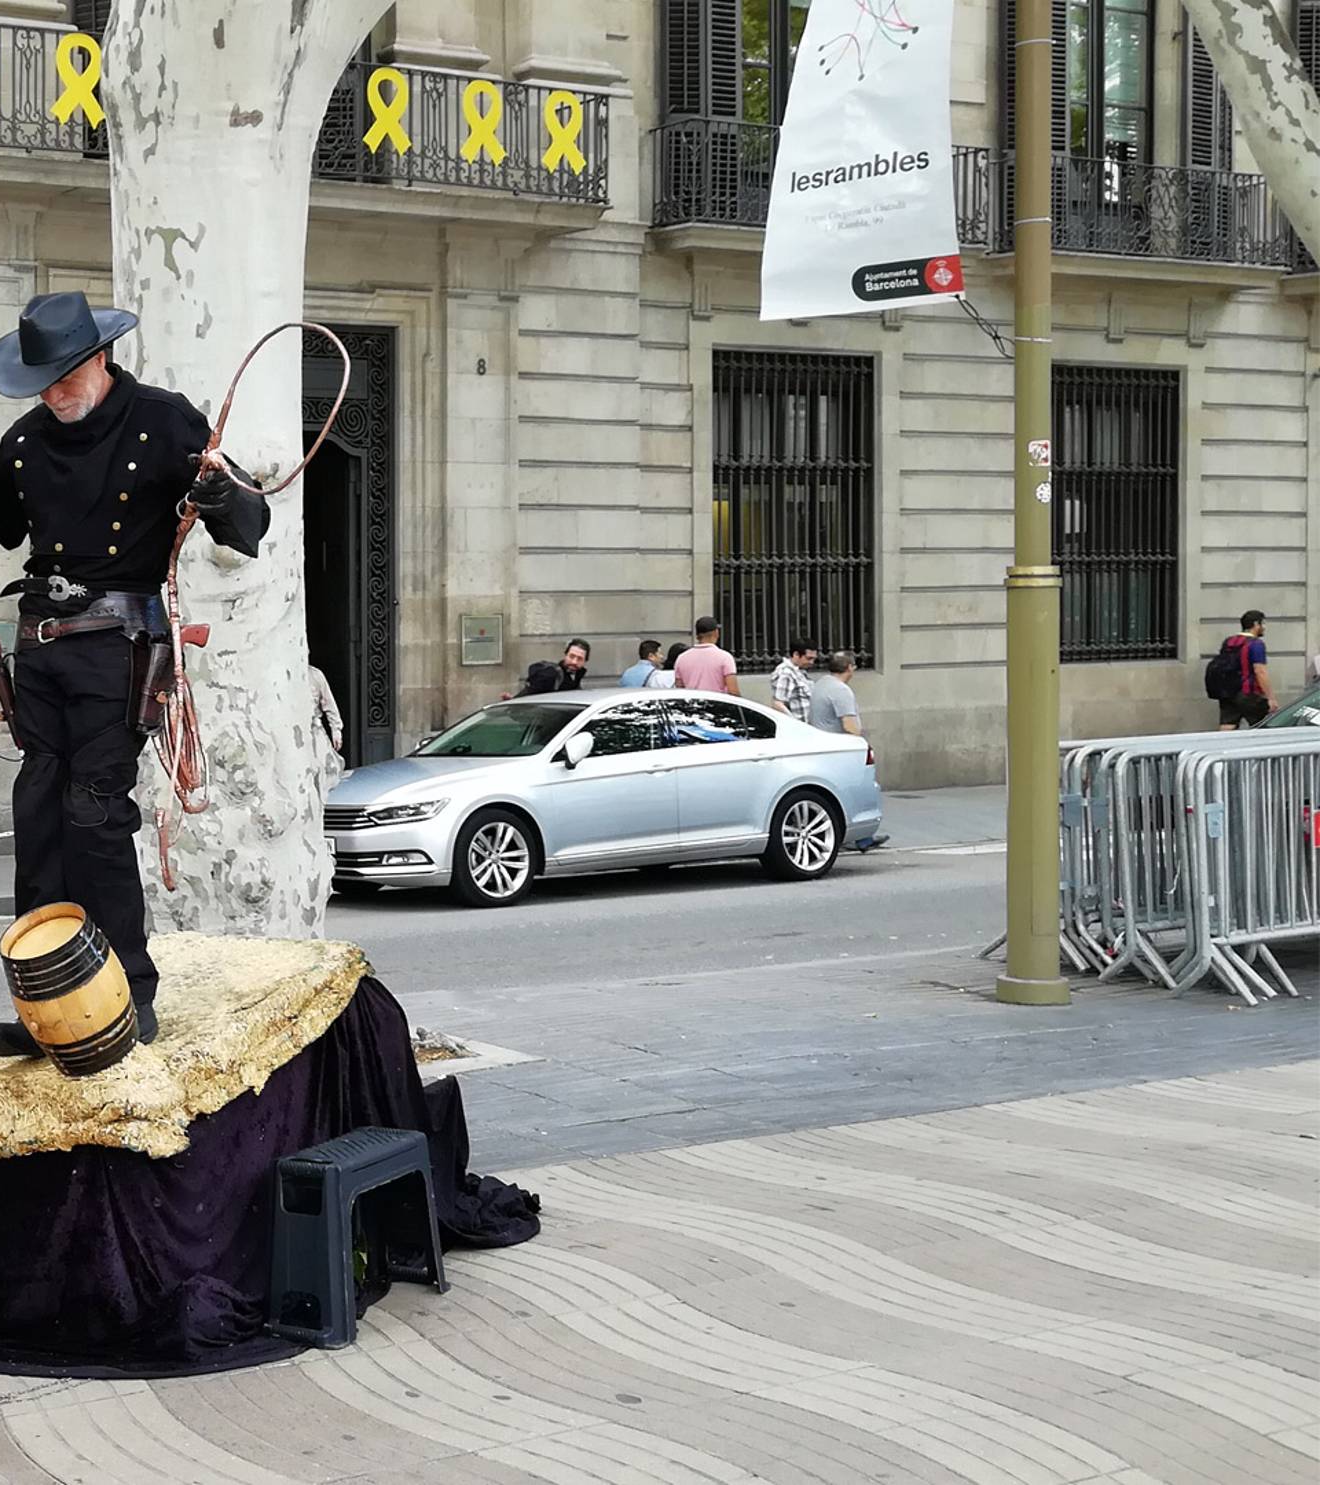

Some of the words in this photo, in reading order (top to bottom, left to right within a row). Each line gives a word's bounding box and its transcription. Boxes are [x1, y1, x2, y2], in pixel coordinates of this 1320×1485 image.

[790, 150, 930, 193] lesrambles
[864, 269, 907, 282] Ajuntament
[908, 268, 918, 276] de
[865, 278, 919, 293] Barcelona
[477, 359, 486, 376] 8
